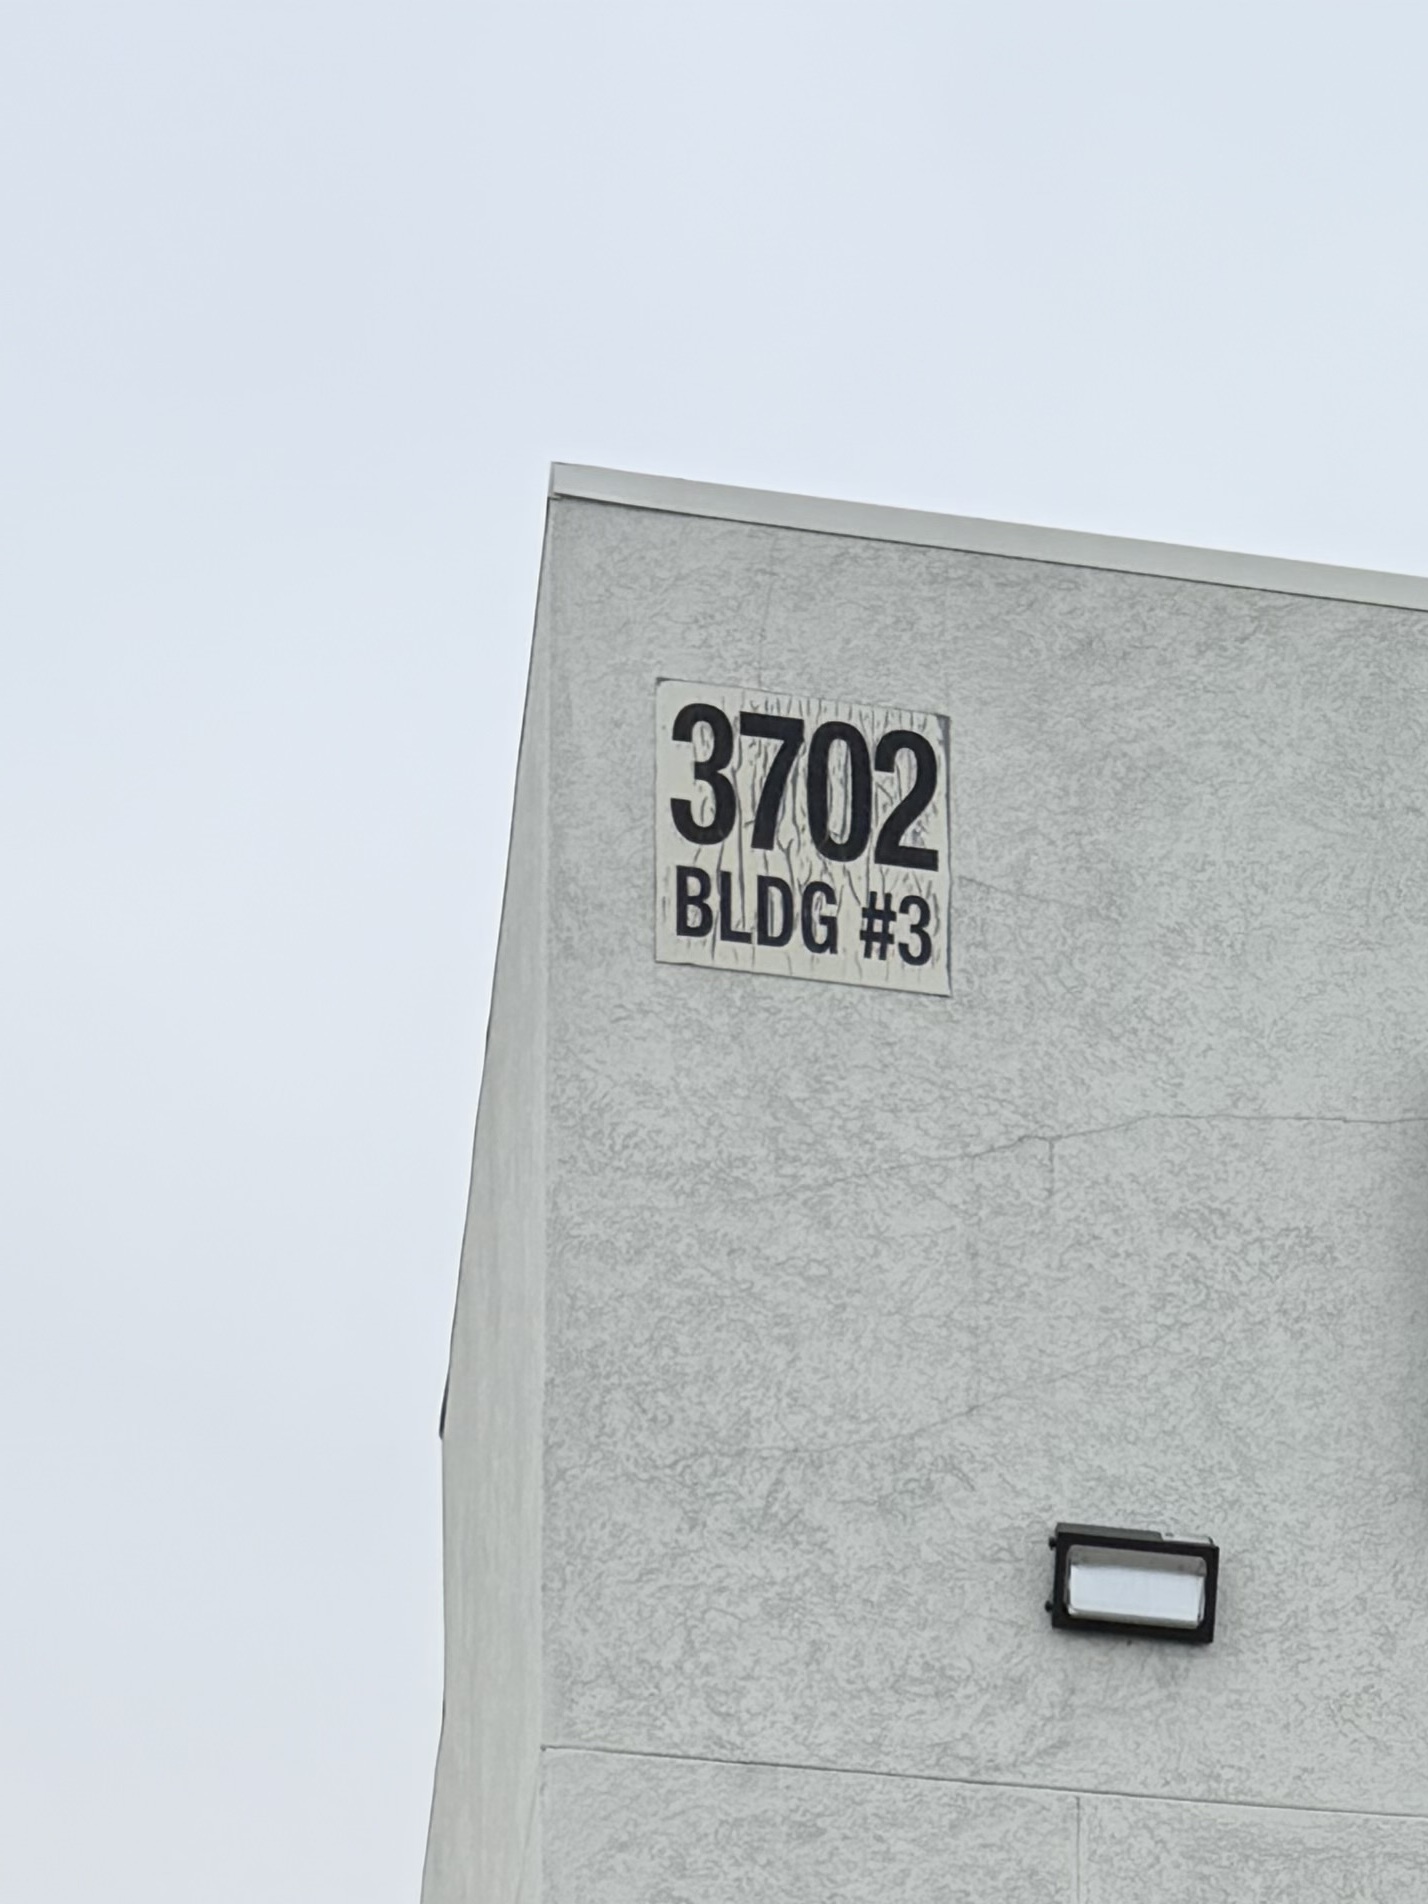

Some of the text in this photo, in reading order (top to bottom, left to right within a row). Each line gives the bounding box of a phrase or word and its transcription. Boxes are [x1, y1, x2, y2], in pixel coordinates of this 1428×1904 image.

[671, 703, 938, 871] 3702
[676, 866, 933, 967] BLDG #3
